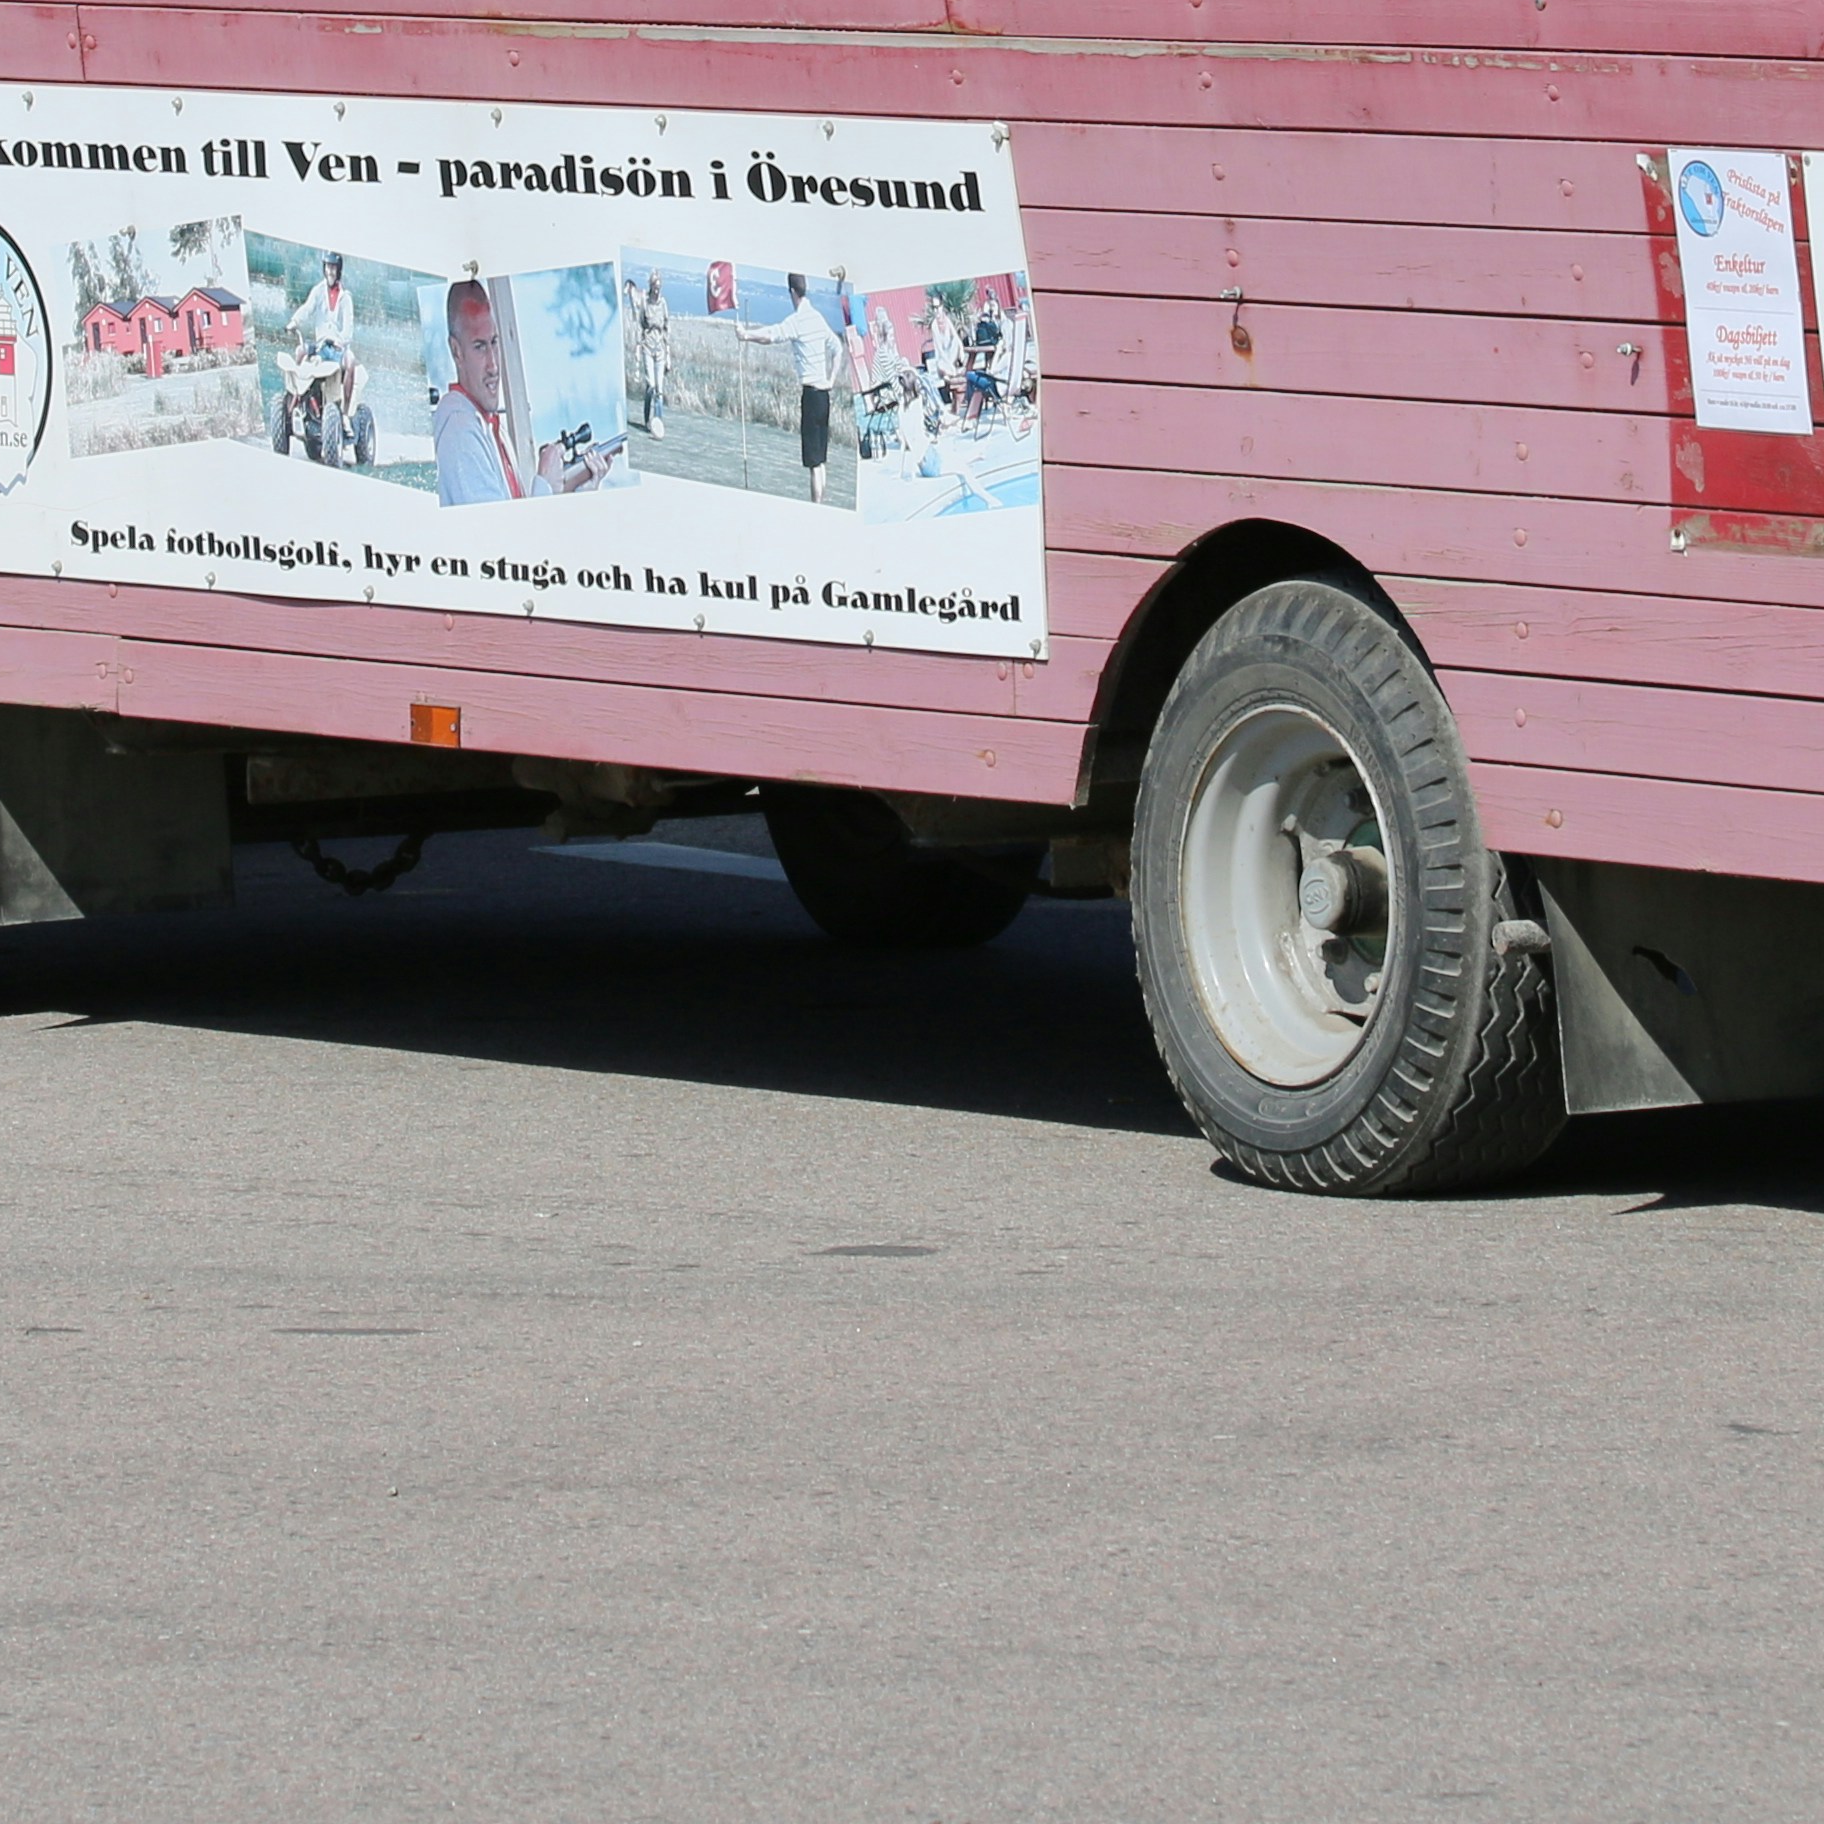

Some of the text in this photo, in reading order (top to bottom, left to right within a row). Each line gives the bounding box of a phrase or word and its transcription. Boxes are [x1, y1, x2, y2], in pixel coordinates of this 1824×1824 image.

[200, 138, 270, 179] till
[281, 139, 383, 184] Ven
[396, 160, 421, 175] -
[435, 152, 696, 199] paradisön
[709, 159, 732, 200] i
[746, 150, 985, 213] Öresund
[1726, 168, 1767, 200] Prislista
[1713, 252, 1766, 277] Enkeltur
[5, 251, 40, 339] VEN
[1716, 323, 1778, 351] Dagsbiljett
[69, 519, 1022, 624] Spela fotbollsgolf, hyr en stuga och ha kul på Gamlegård
